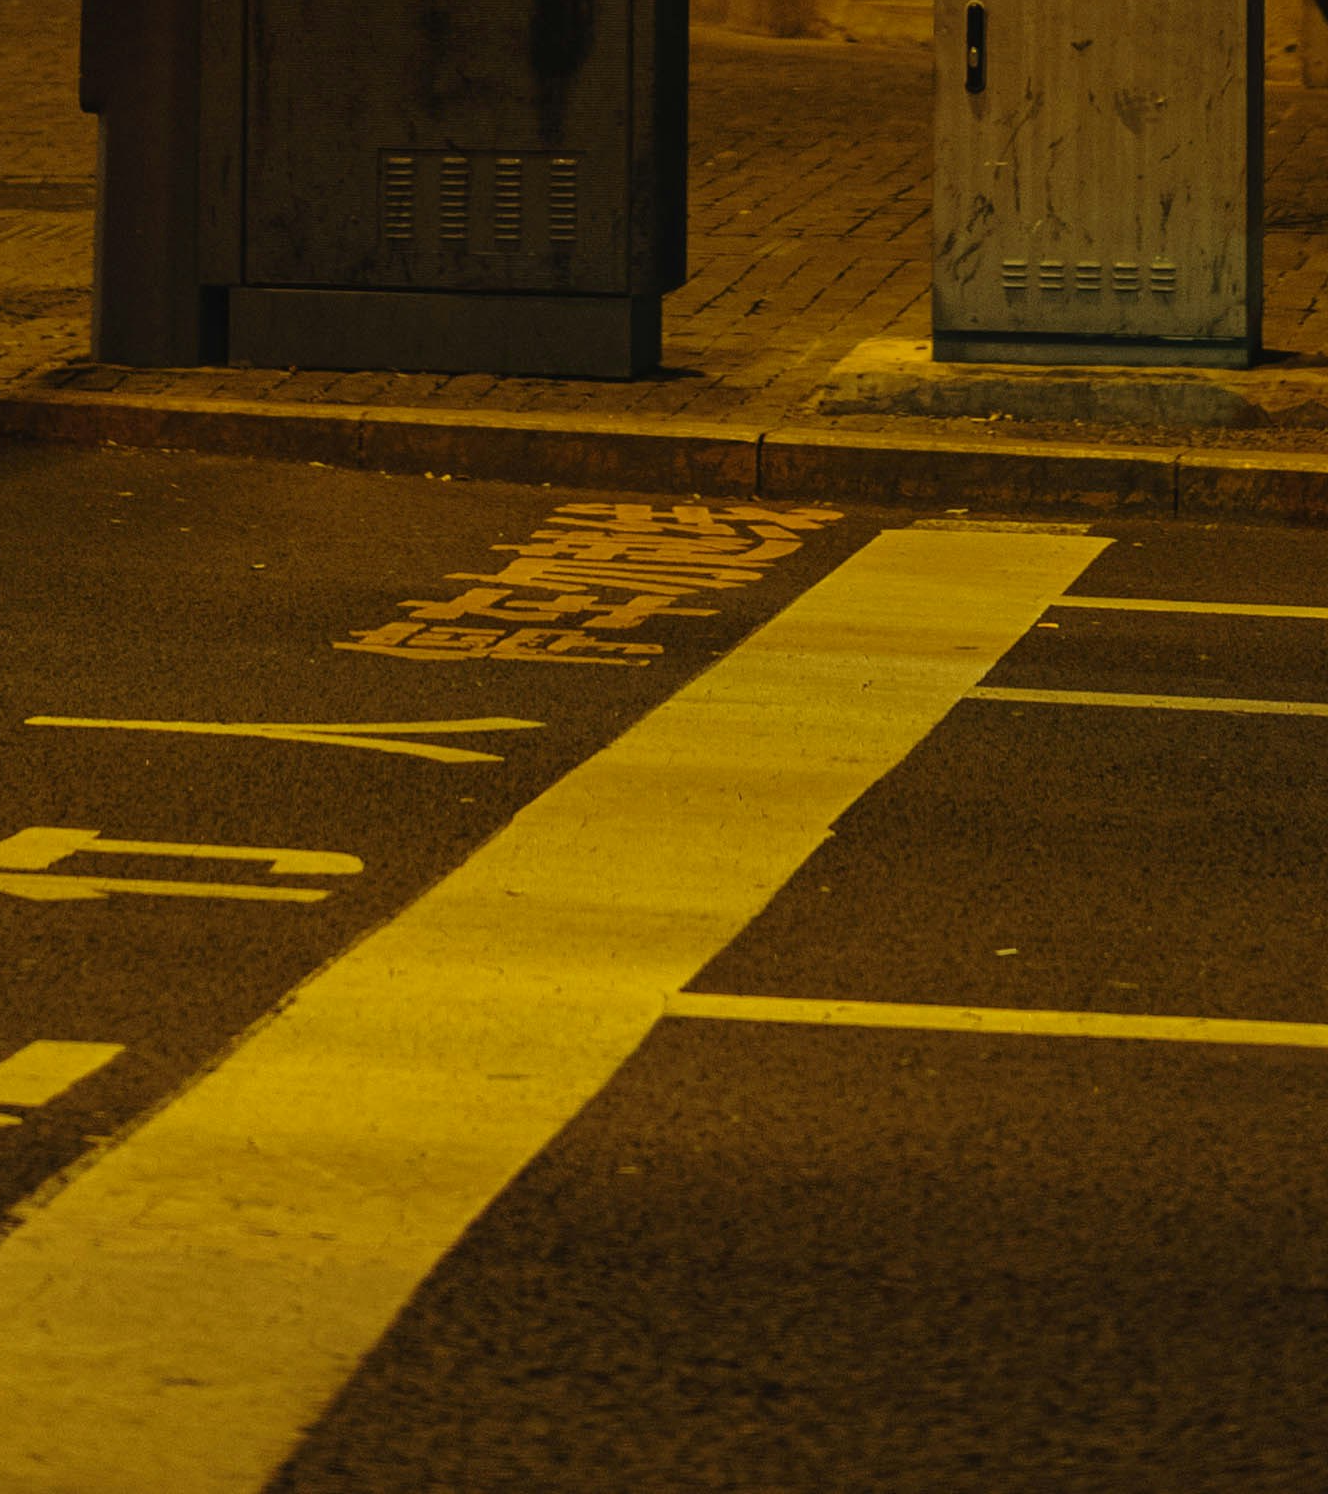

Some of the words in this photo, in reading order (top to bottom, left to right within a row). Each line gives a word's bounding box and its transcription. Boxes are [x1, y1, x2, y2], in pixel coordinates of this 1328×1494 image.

[331, 502, 845, 667] 停车勿越线
